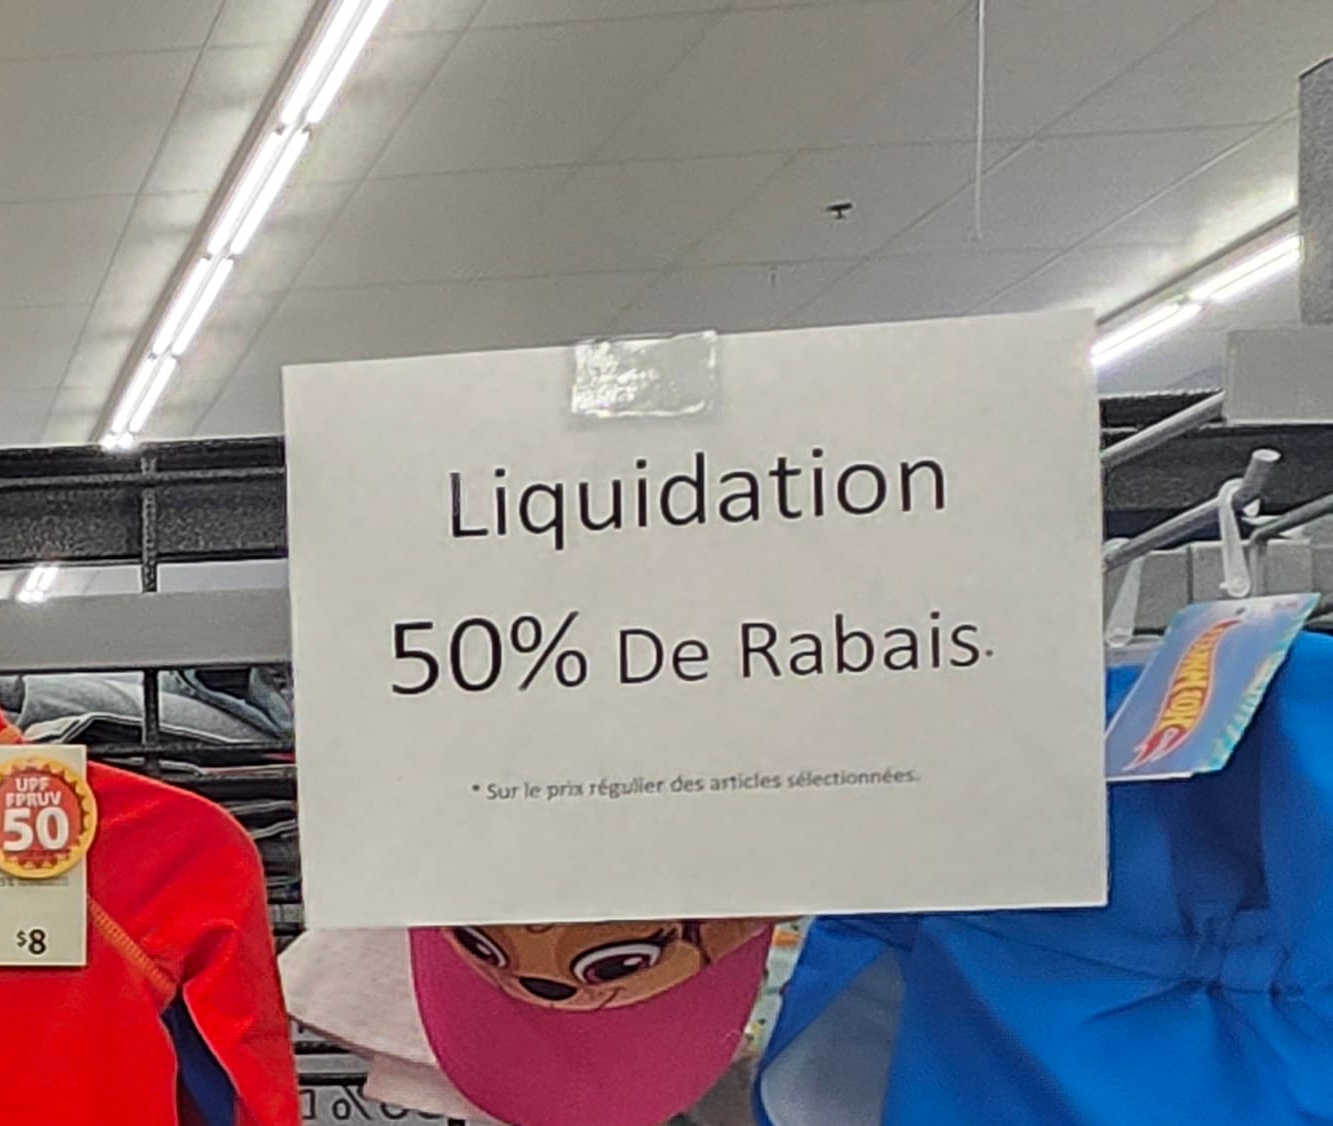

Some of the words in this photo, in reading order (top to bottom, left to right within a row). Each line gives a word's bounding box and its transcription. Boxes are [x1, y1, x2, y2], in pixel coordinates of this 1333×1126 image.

[450, 448, 945, 551] Liquidation
[392, 611, 587, 695] 50%
[619, 628, 709, 684] De
[15, 777, 51, 792] UPF
[487, 783, 519, 800] Sur
[523, 781, 542, 798] le
[546, 780, 584, 801] prix
[589, 777, 665, 799] régulier
[670, 774, 705, 793] des
[710, 772, 782, 790] articles
[2, 806, 70, 852] 50
[16, 929, 47, 955] $8
